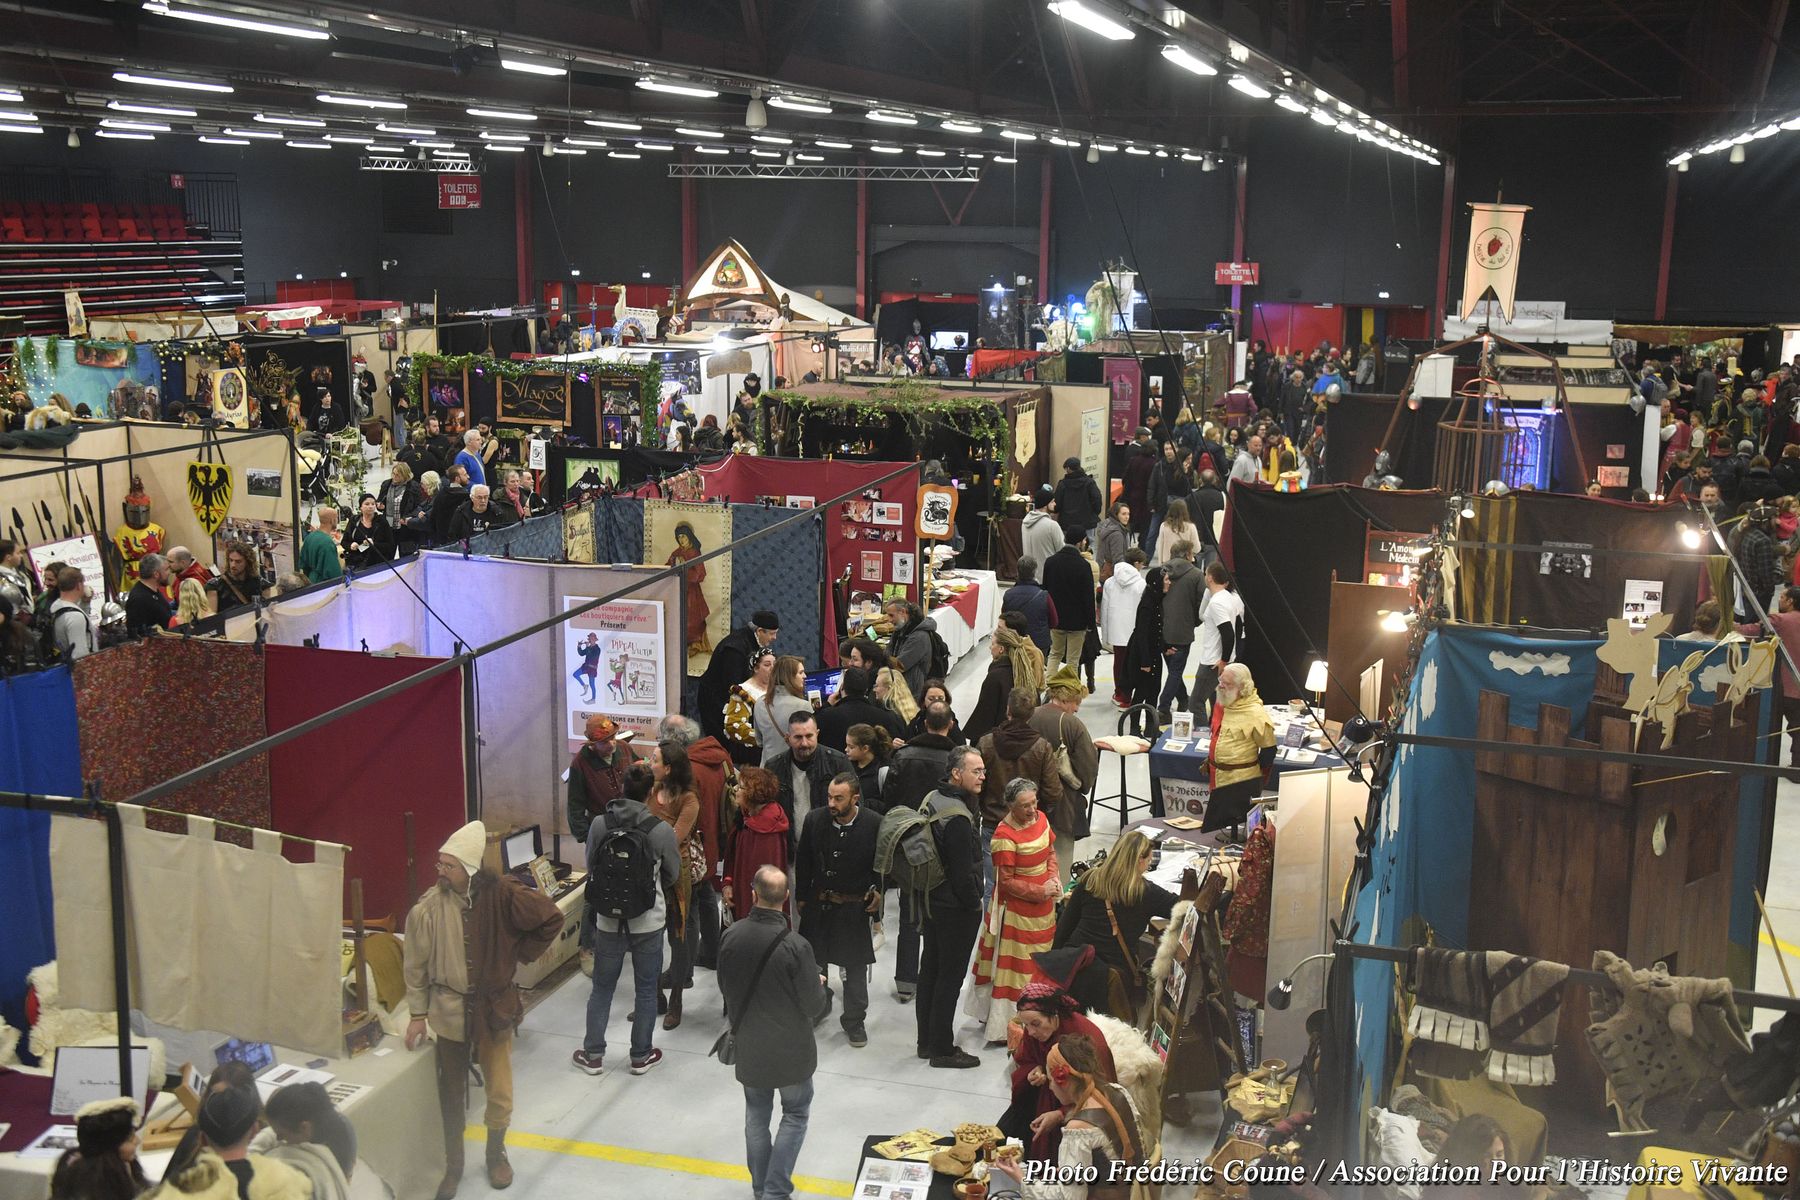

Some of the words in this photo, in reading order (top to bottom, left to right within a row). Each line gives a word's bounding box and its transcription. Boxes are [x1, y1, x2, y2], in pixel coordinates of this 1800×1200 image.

[443, 183, 478, 194] TOILETTES
[600, 620, 627, 630] Présente
[636, 716, 652, 725] forêt
[1177, 786, 1209, 796] Médiév
